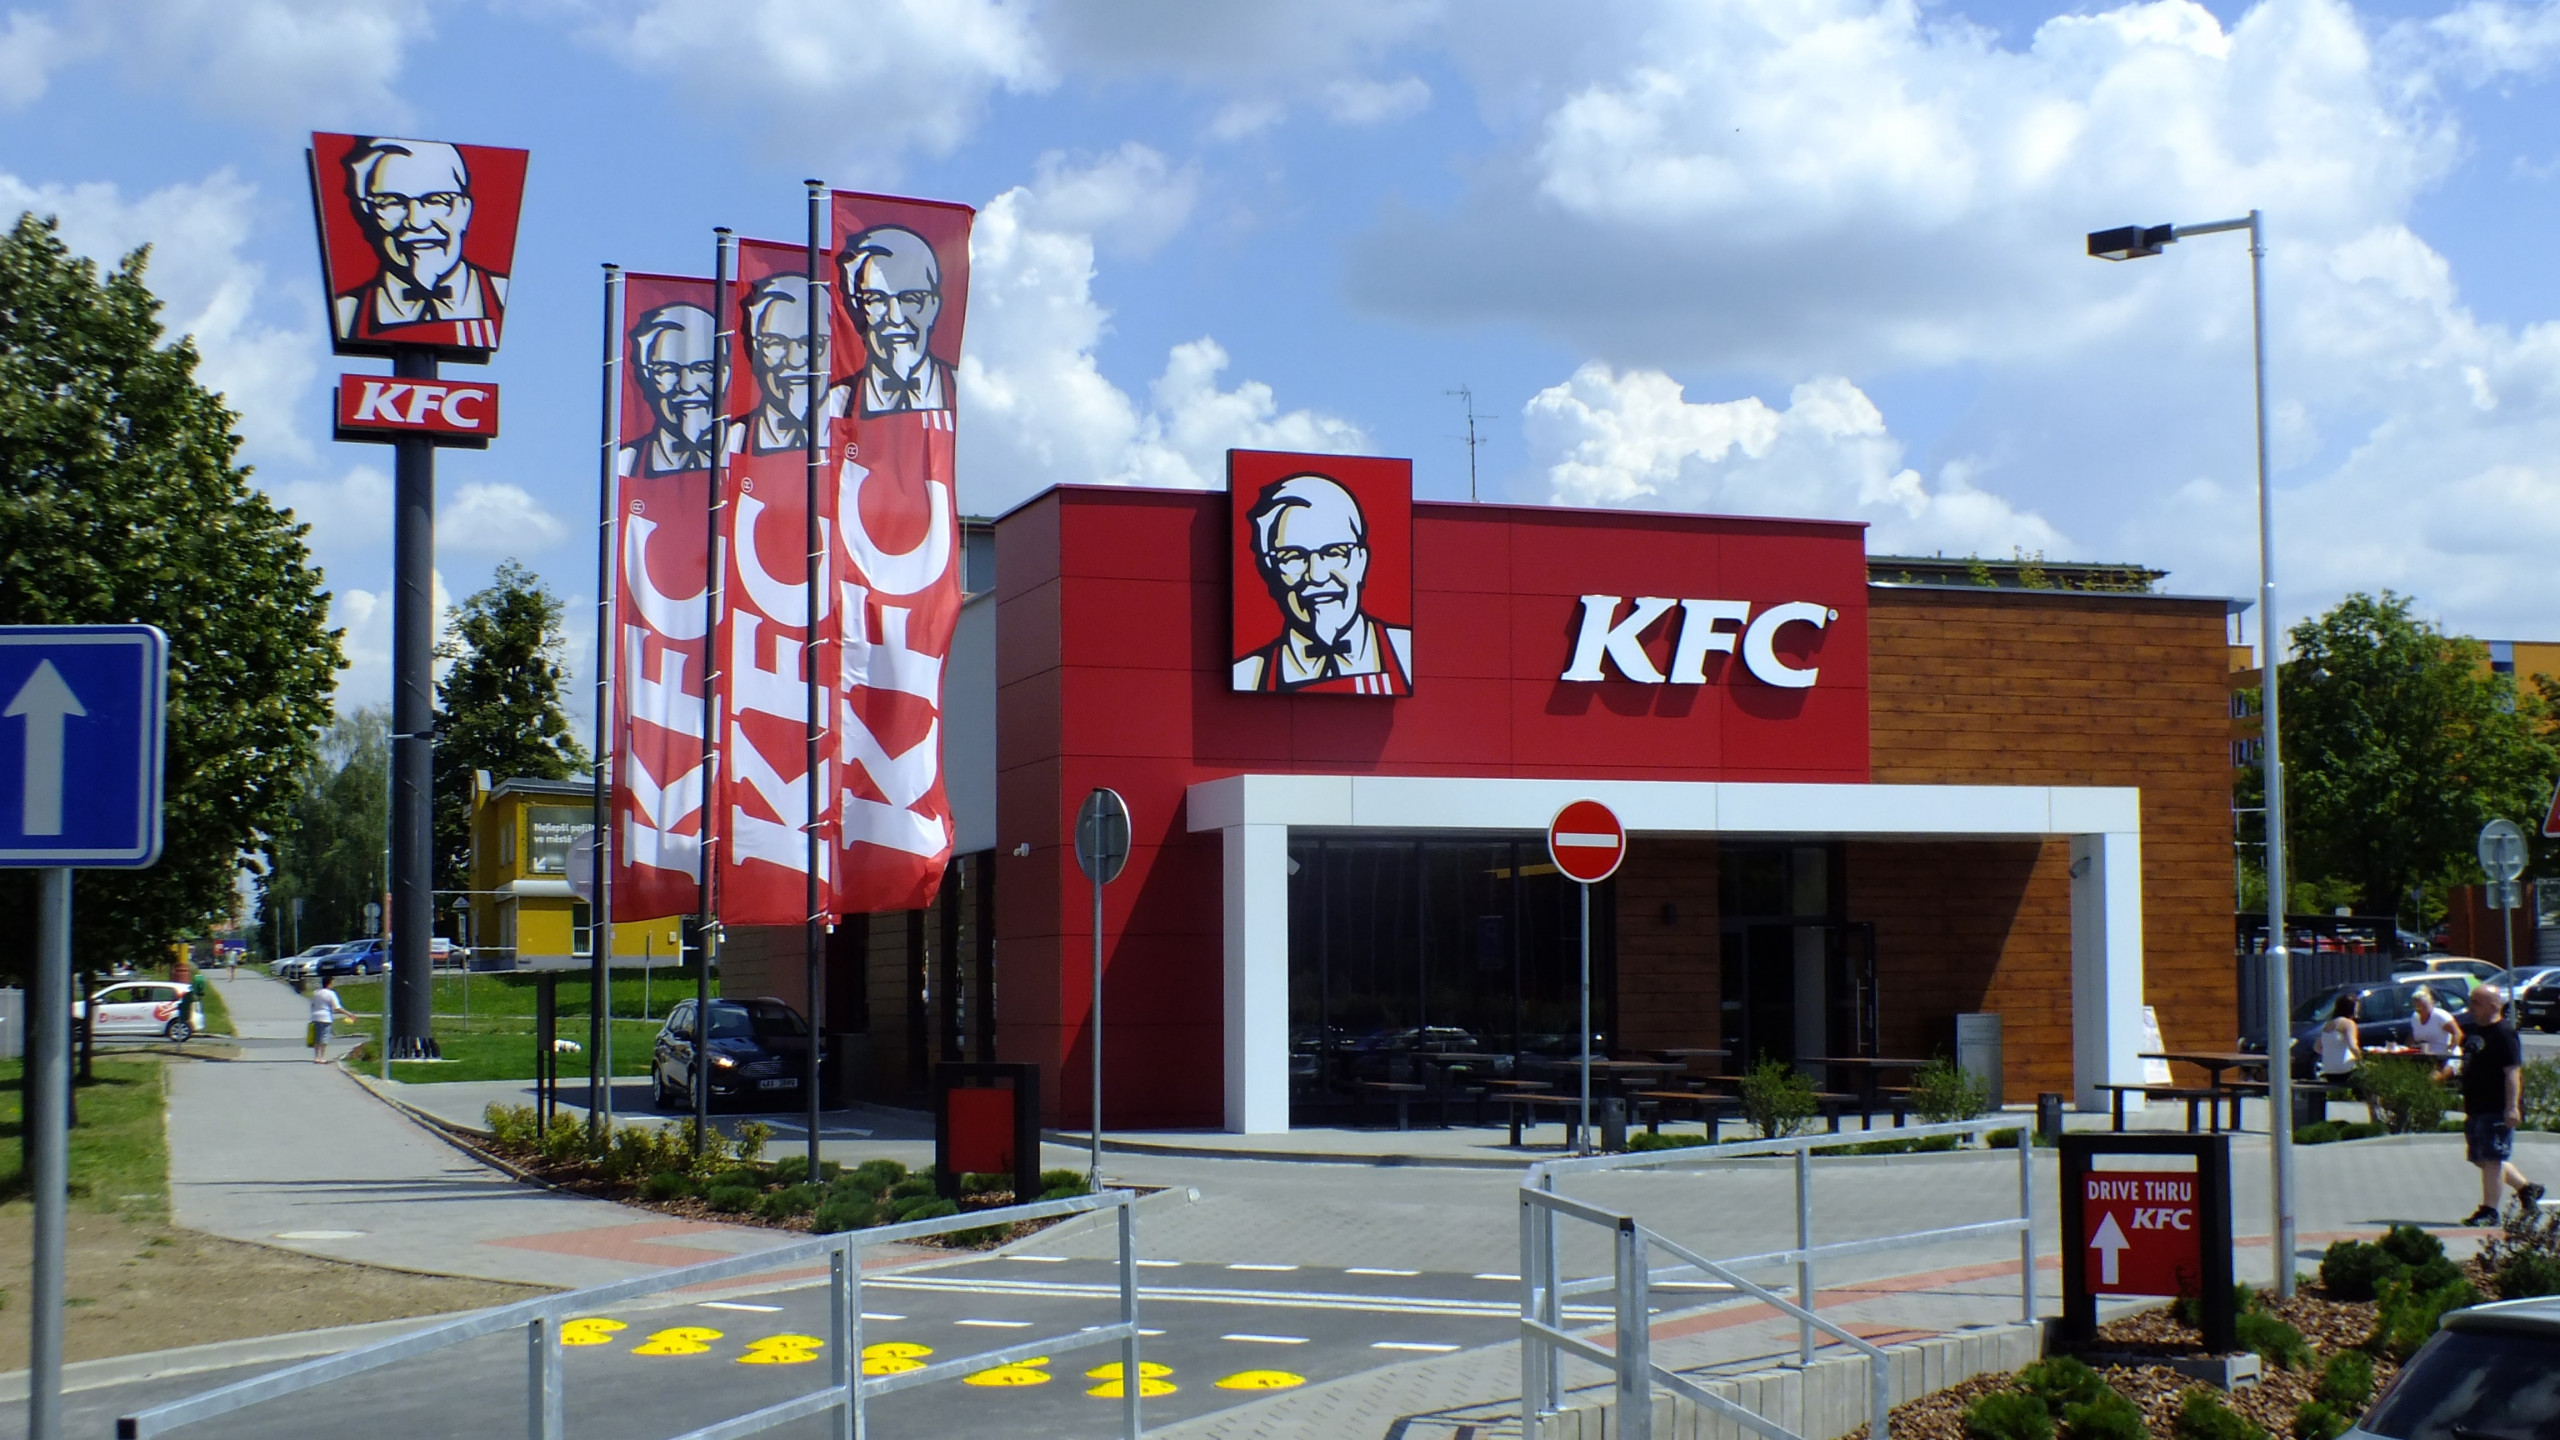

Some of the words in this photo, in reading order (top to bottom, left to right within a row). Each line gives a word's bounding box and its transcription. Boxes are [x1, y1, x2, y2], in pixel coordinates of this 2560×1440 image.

[353, 381, 488, 428] KFC
[732, 491, 831, 884] KFC
[837, 458, 952, 860] KFC
[1560, 594, 1830, 688] KFC
[624, 513, 728, 886] KFC
[2088, 1181, 2139, 1201] DRIVE
[2145, 1181, 2192, 1202] THRU
[2131, 1207, 2193, 1230] KFC
